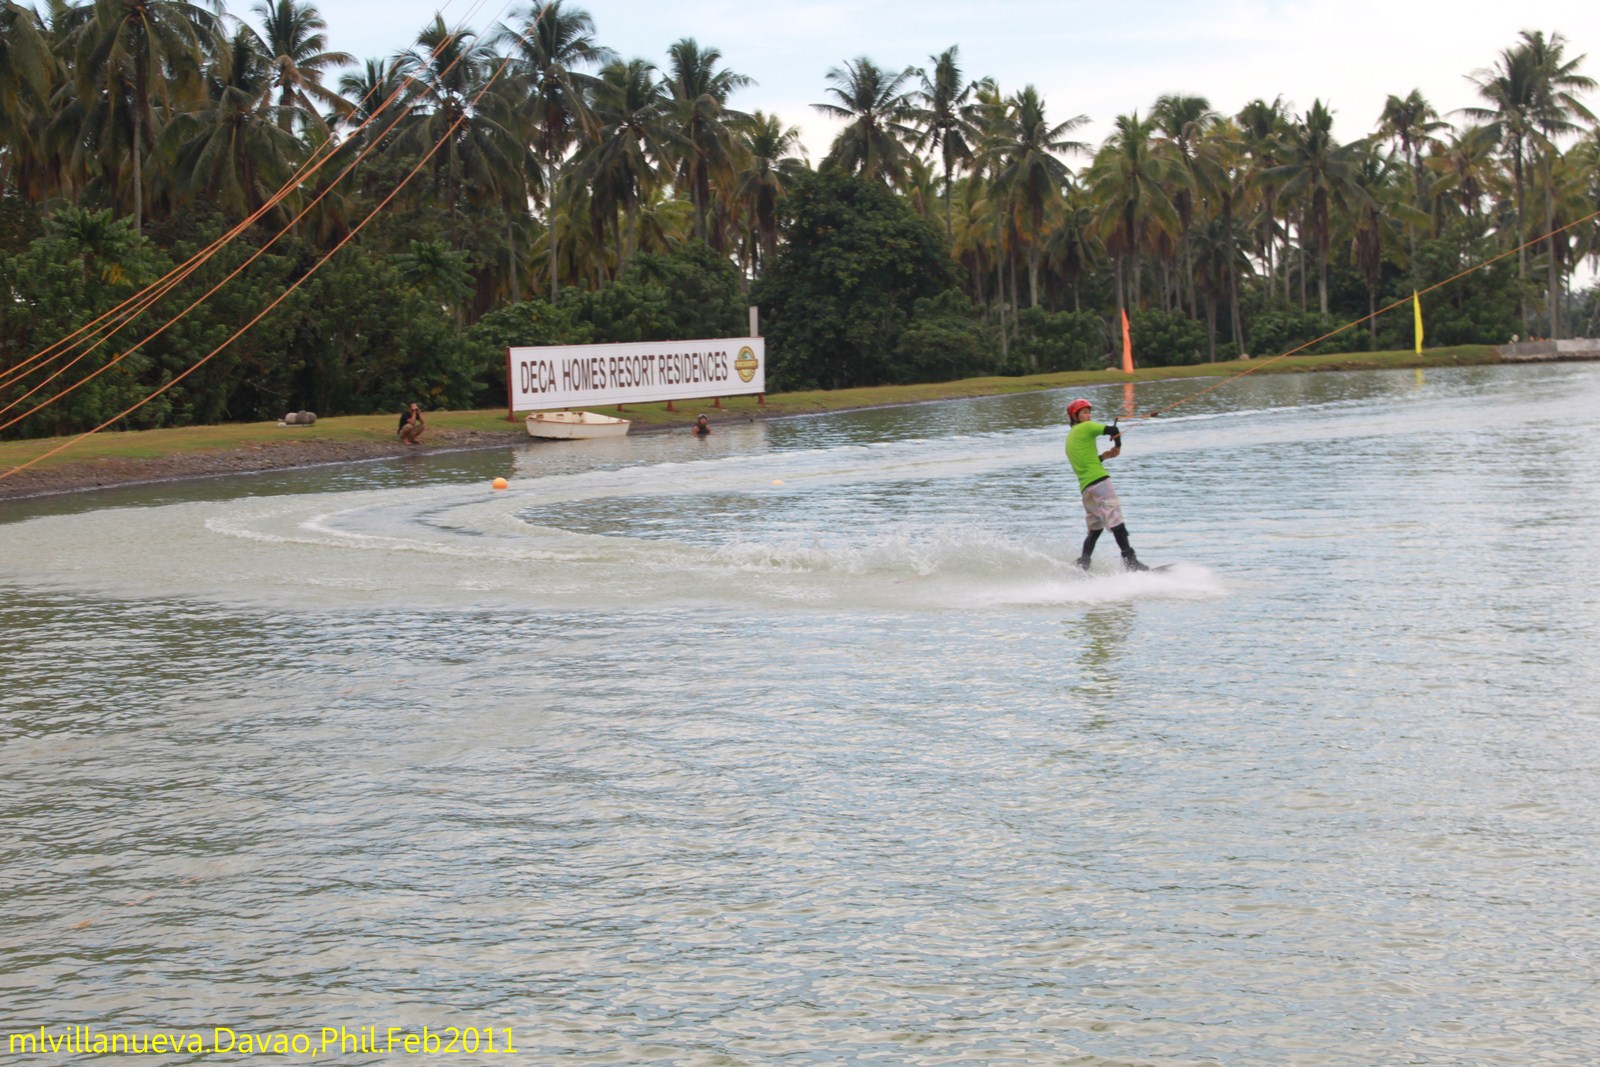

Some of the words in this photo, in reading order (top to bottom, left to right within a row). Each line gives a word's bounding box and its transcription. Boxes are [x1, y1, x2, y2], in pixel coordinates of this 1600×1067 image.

[520, 360, 557, 394] DECA
[562, 357, 607, 391] HOMES
[609, 355, 655, 388] RESORT
[658, 351, 728, 385] RESIDENCES
